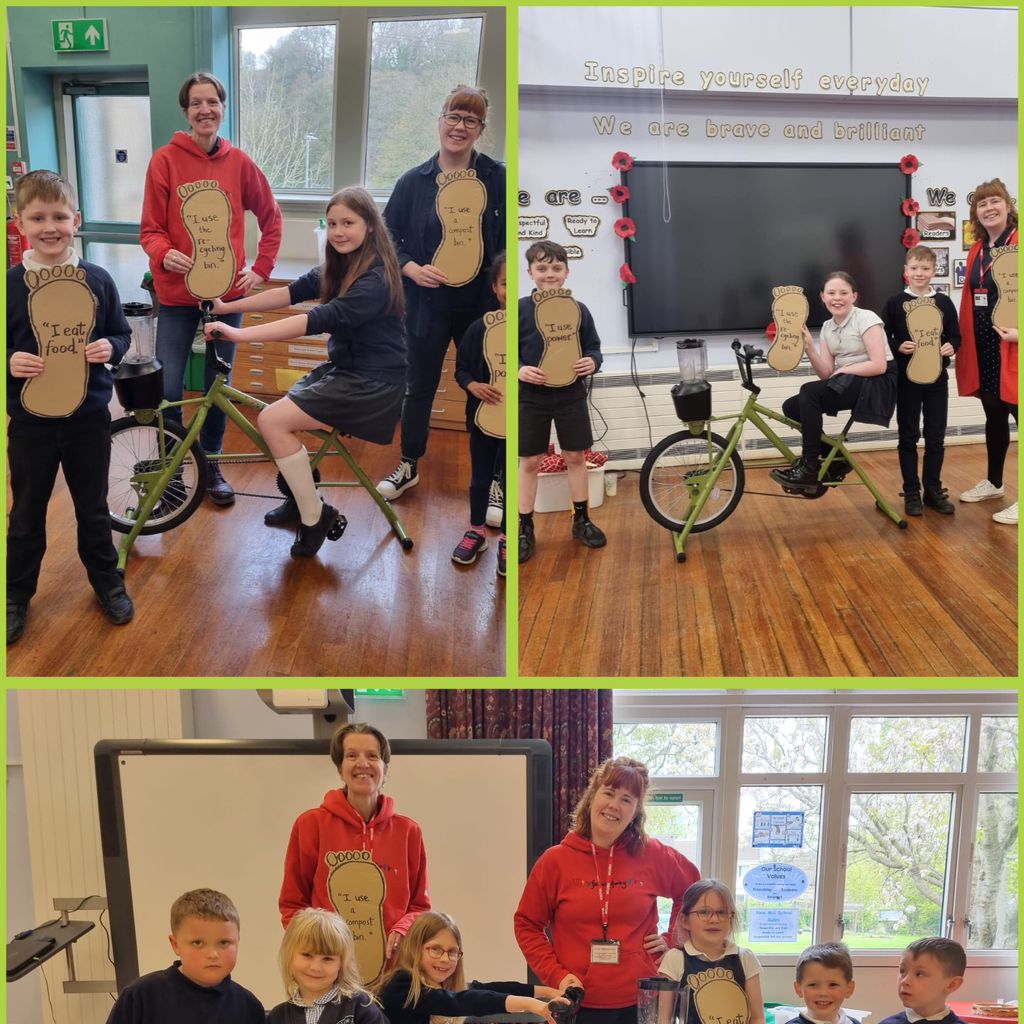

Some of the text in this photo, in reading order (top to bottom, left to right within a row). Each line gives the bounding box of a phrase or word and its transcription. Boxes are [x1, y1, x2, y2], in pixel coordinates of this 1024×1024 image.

[584, 61, 930, 96] Inspire yourself everyday
[593, 115, 926, 141] We are brave and brilliant
[518, 190, 530, 207] e
[545, 189, 582, 206] are
[926, 187, 957, 207] We
[567, 217, 587, 225] Ready
[42, 321, 86, 338] "I eat
